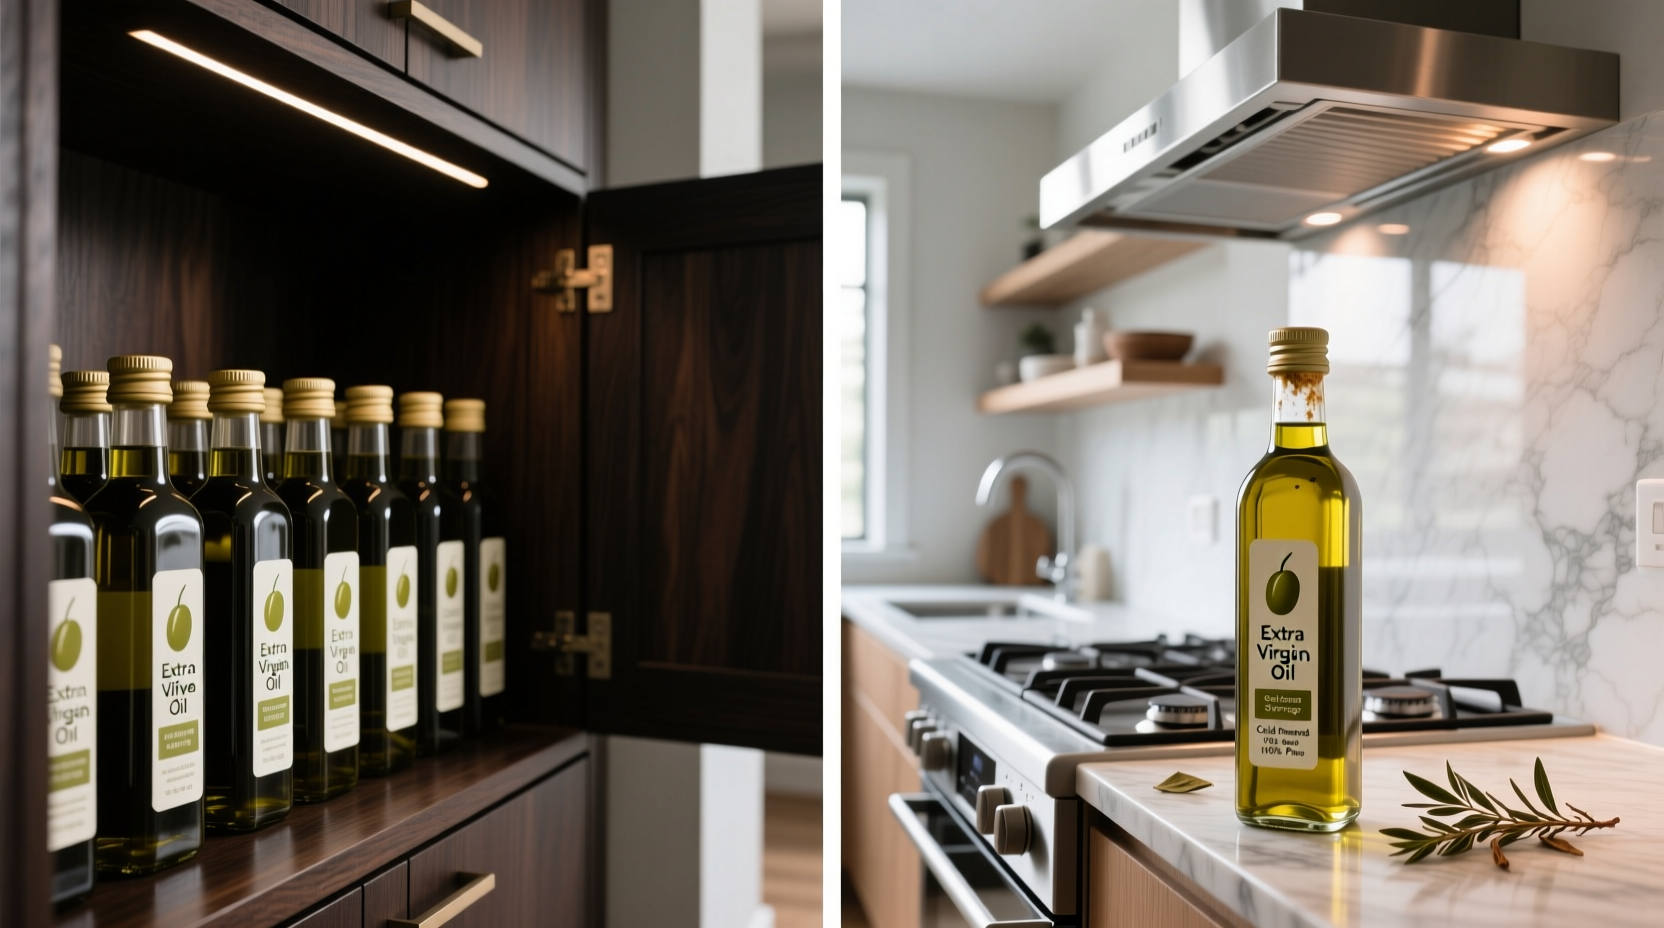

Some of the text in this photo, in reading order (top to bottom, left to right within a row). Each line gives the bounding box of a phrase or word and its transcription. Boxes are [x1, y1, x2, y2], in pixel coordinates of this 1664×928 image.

[1261, 625, 1305, 641] Extra
[1257, 643, 1310, 665] Virgin
[1271, 664, 1295, 681] Oil
[266, 674, 281, 691] Oil
[170, 698, 187, 715] Oil
[55, 725, 78, 745] Oil
